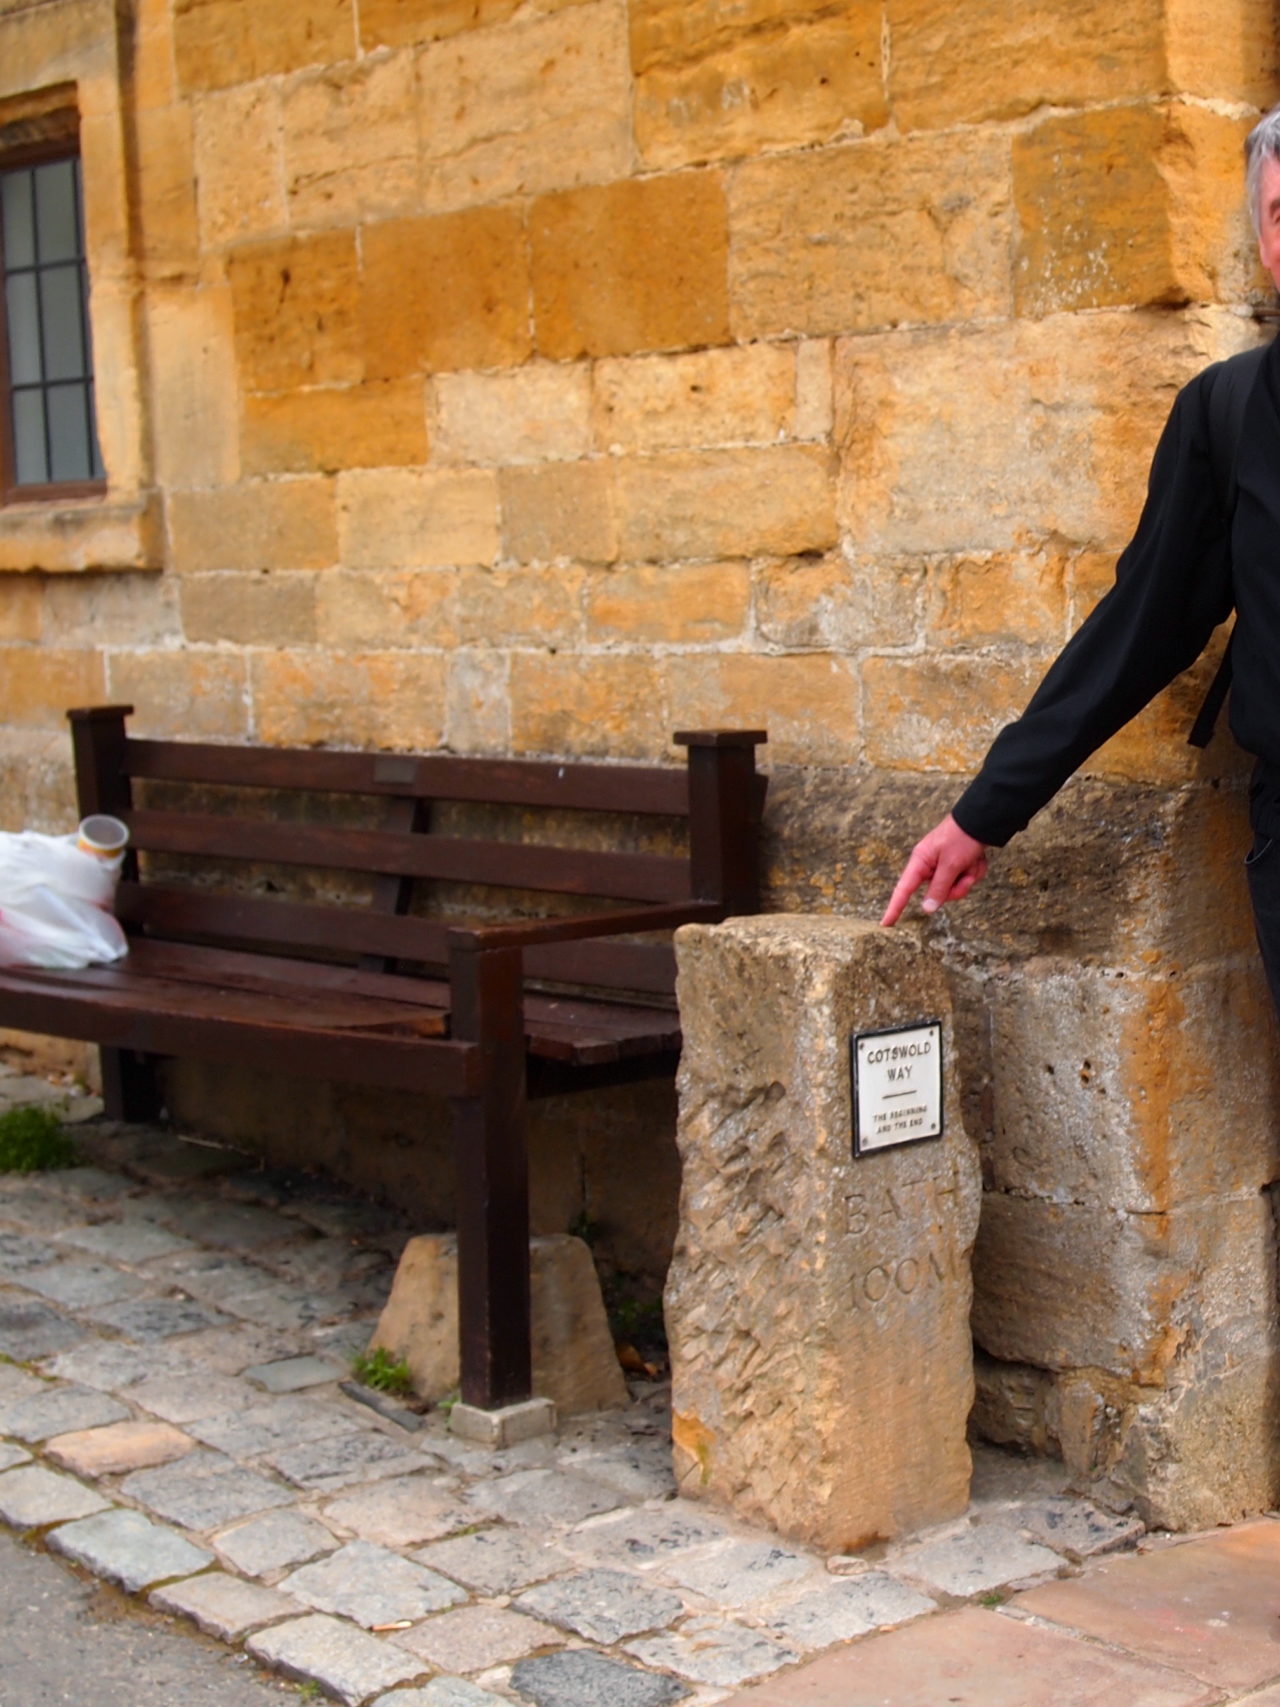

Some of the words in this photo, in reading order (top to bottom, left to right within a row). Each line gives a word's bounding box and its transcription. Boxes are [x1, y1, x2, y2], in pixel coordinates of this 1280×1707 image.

[867, 1041, 931, 1064] COTSWOLD
[887, 1066, 913, 1081] WAY
[873, 1112, 888, 1122] THE
[877, 1125, 891, 1134] AND
[895, 1122, 908, 1130] THE
[909, 1118, 924, 1128] END
